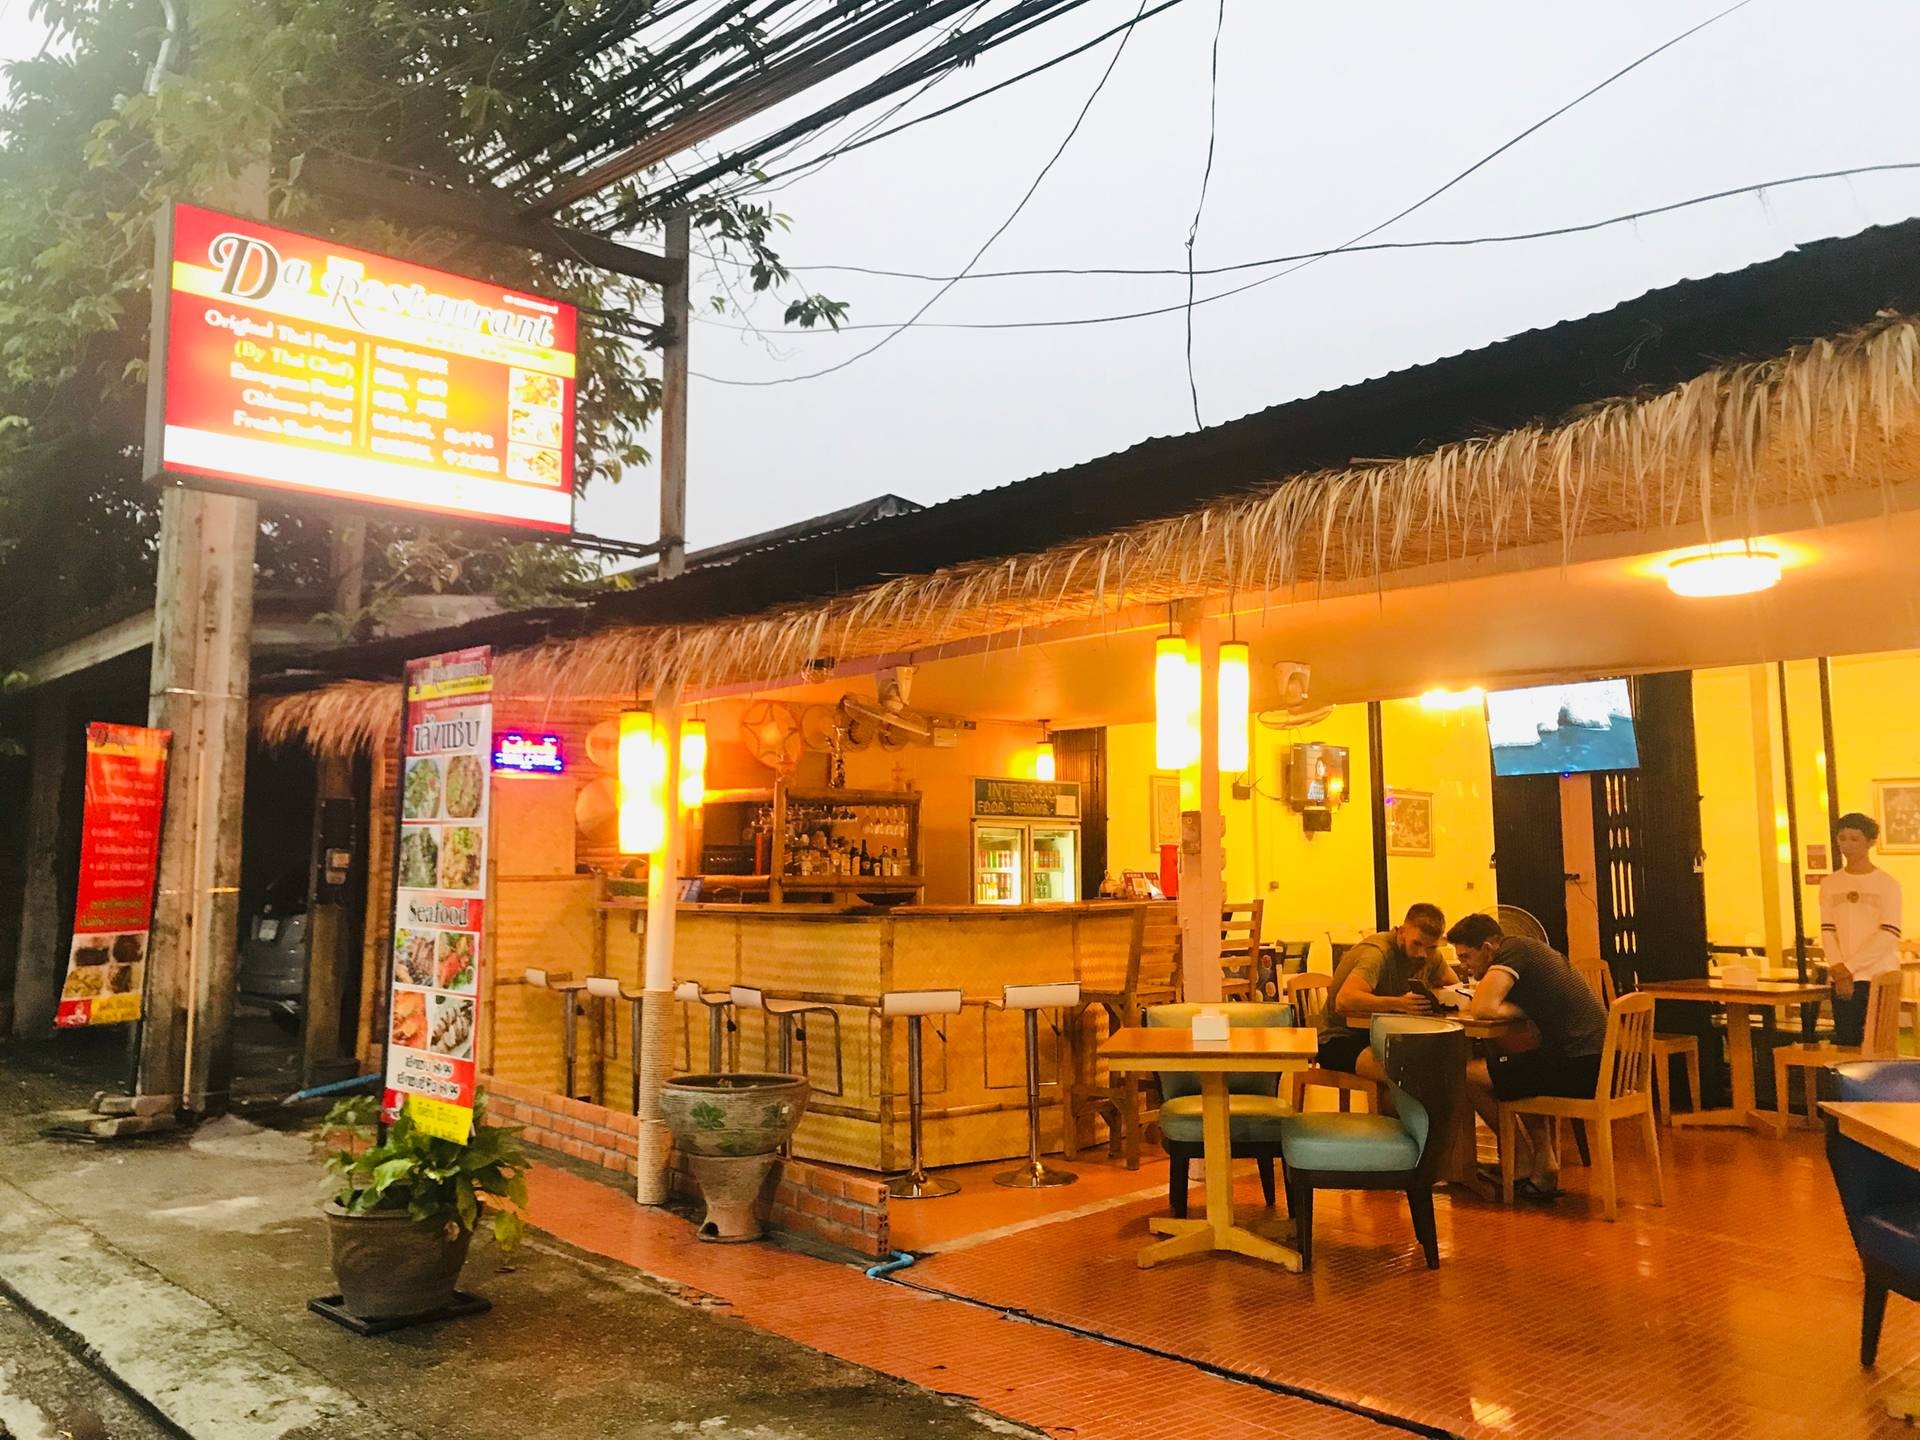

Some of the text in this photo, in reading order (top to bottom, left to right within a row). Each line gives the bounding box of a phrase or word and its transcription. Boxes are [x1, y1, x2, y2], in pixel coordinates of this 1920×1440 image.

[208, 232, 556, 348] Da Restaurant
[204, 309, 274, 338] Original
[277, 325, 312, 347] Thai
[408, 899, 468, 926] Seafood
